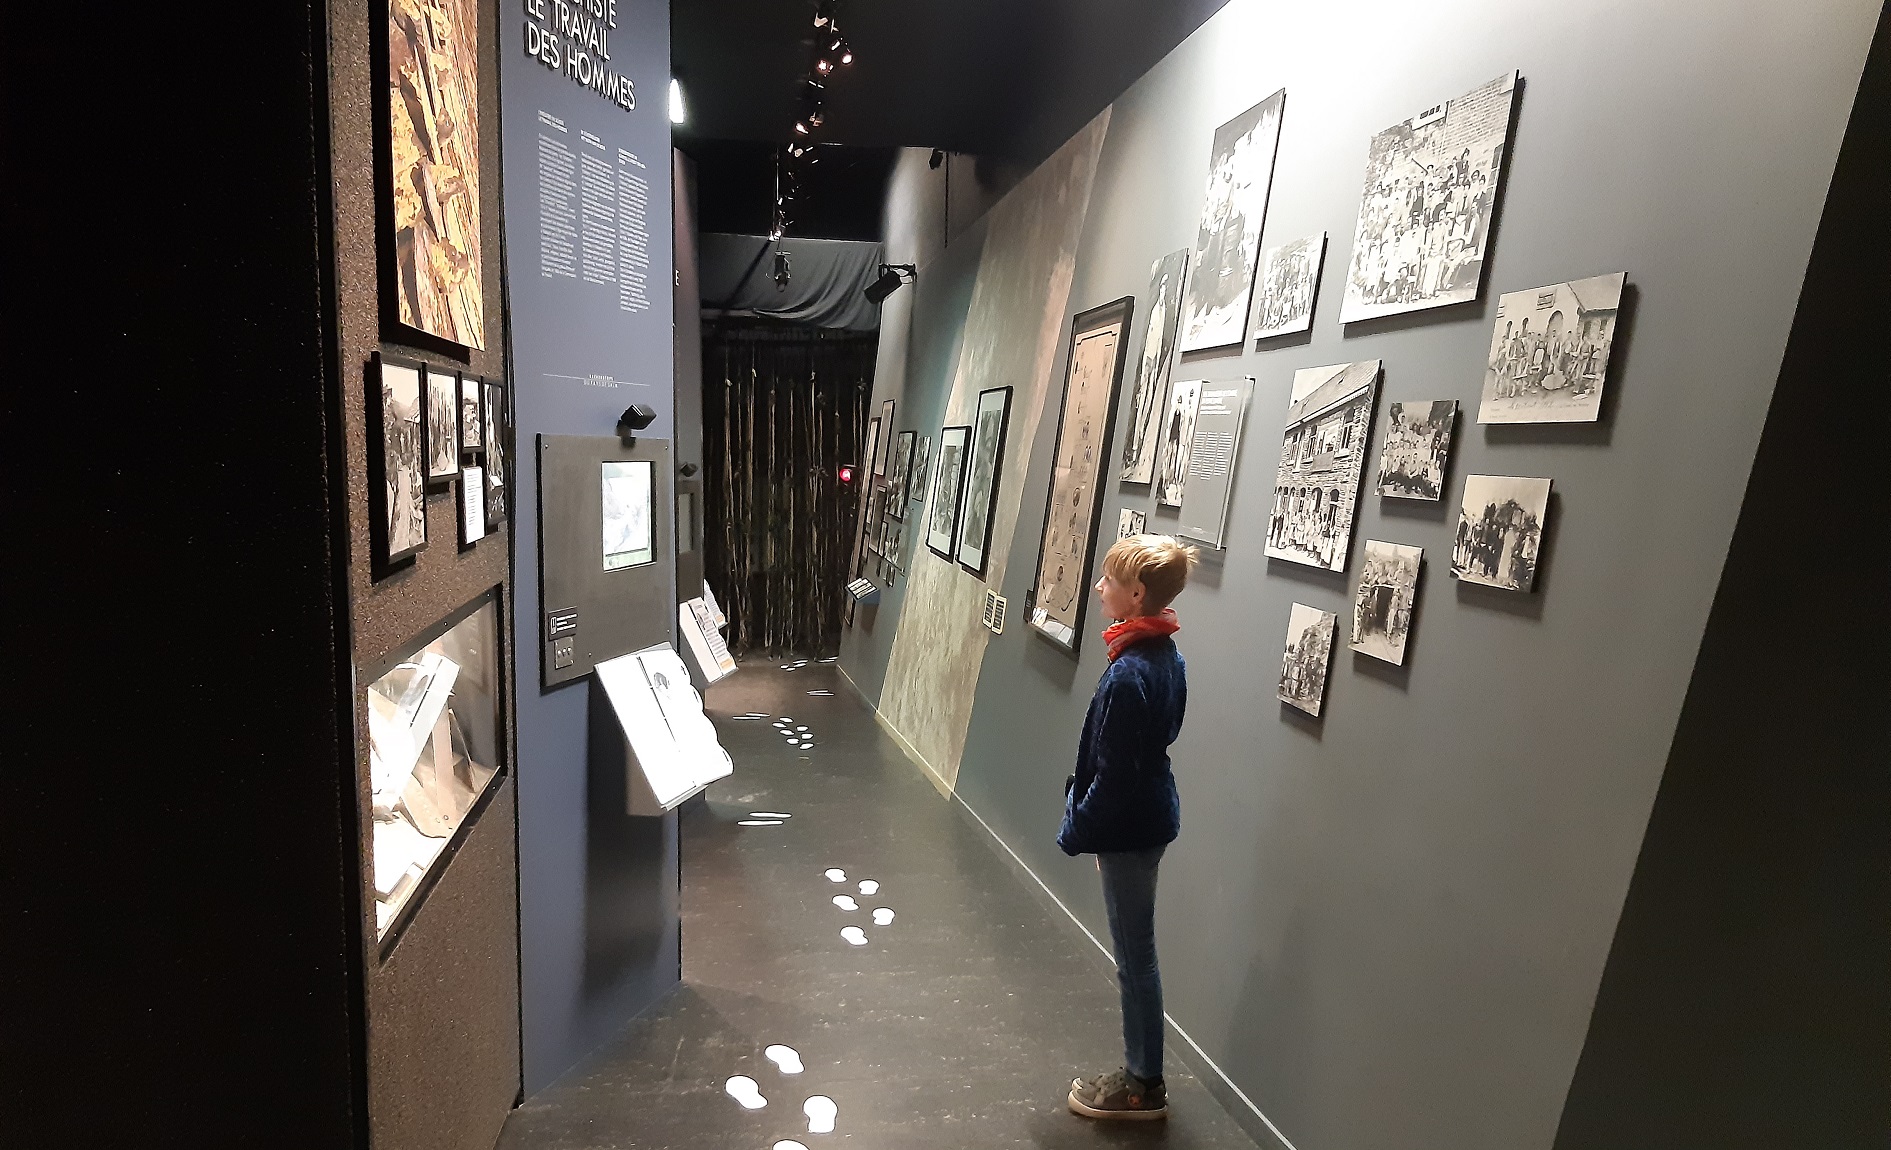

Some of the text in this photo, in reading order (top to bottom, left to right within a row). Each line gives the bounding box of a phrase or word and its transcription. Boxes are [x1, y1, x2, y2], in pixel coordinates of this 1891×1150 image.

[527, 20, 636, 111] DES HOMMES
[552, 0, 611, 61] TRAVAIL
